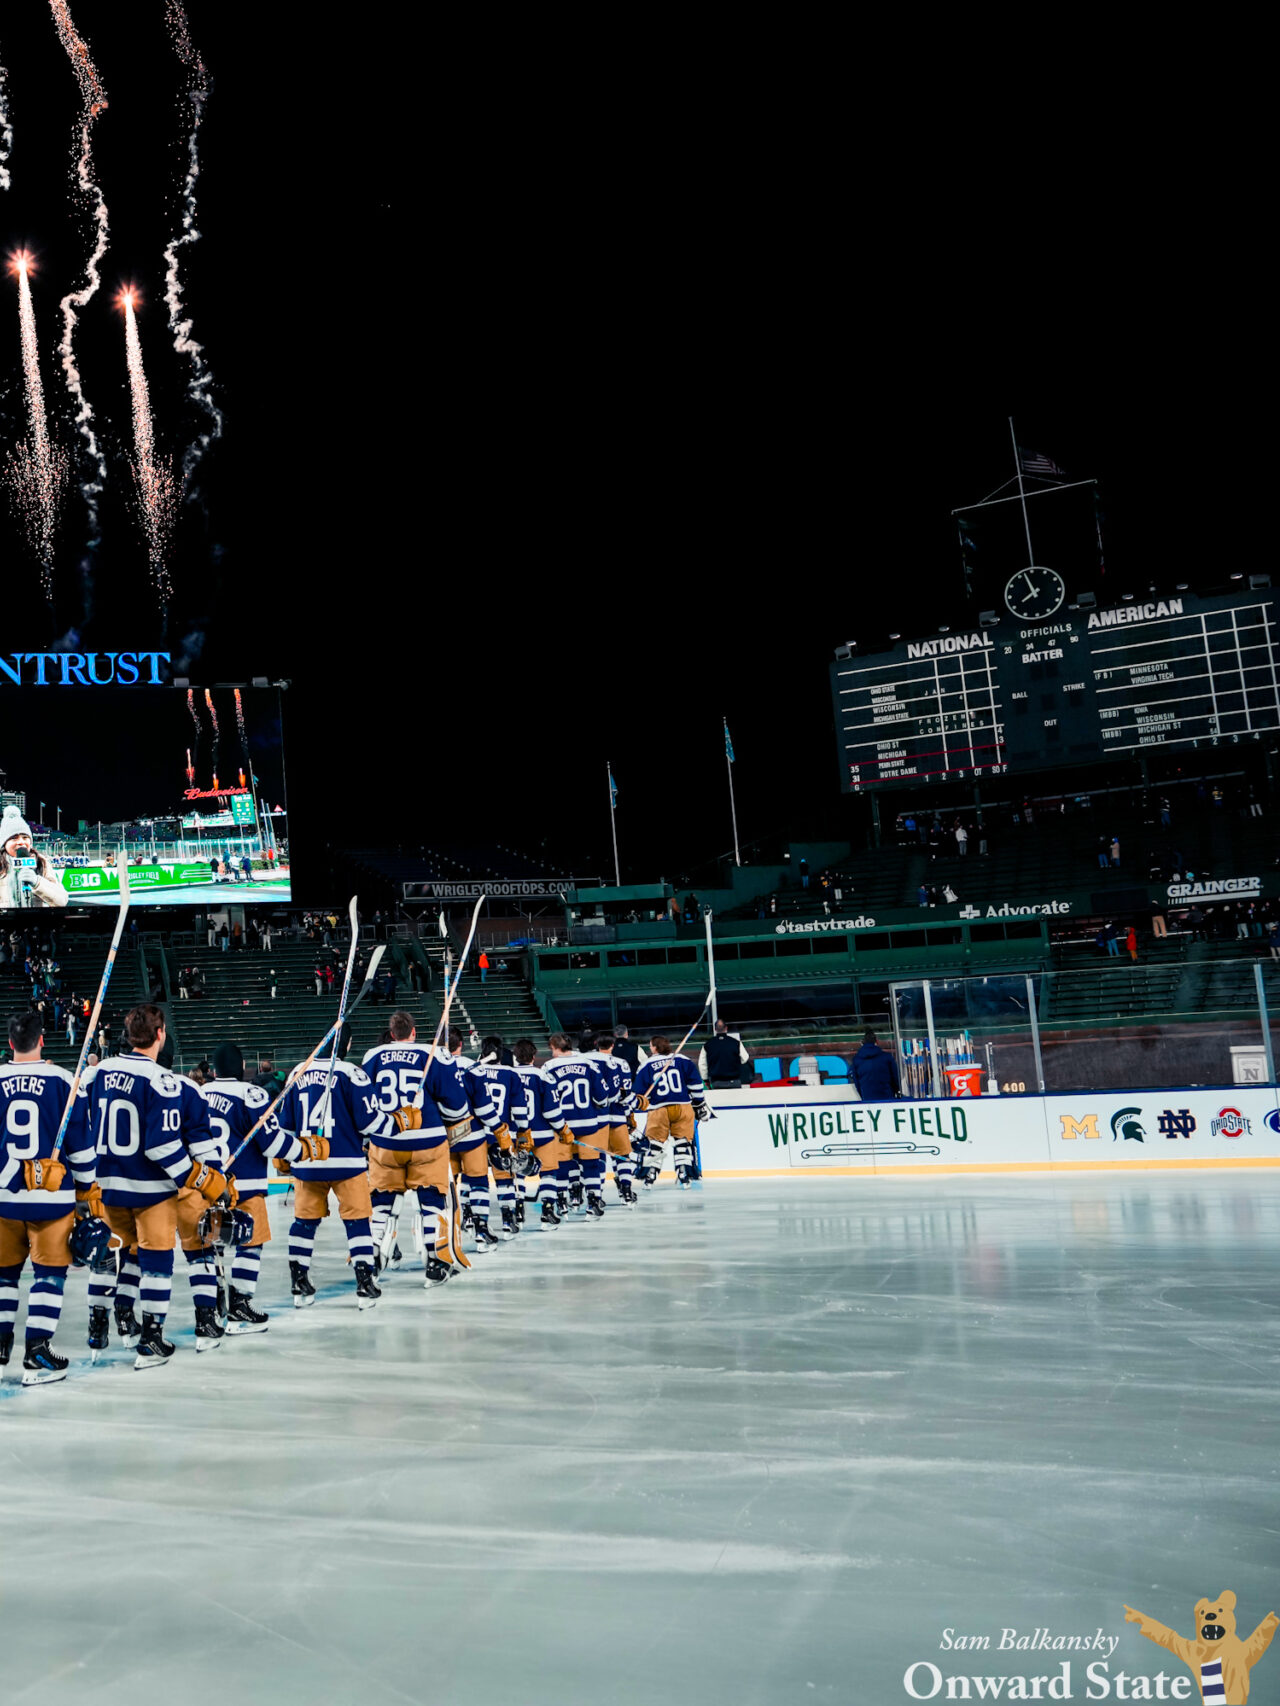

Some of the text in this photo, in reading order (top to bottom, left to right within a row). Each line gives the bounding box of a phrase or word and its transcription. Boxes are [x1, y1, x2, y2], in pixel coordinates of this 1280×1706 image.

[1087, 598, 1184, 629] AMERICAN
[1020, 623, 1073, 639] OFFICIALS
[907, 632, 993, 658] NATIONAL
[1021, 648, 1064, 664] BATTER
[1130, 663, 1169, 675] MINNESOTA
[1158, 671, 1174, 680] TECH
[1062, 682, 1086, 692] STRIKE
[1011, 691, 1028, 700] BALL
[872, 703, 906, 714] WISCONSIN
[1044, 718, 1057, 727] OUT
[1136, 712, 1175, 724] WISCONSIN
[1137, 721, 1181, 734] MICHIGAN ST
[1139, 735, 1156, 743] OHIO
[1193, 732, 1260, 748] 1 2 3 4
[850, 766, 860, 774] 35
[900, 766, 918, 776] DAME
[924, 774, 929, 783] 1
[942, 772, 947, 781] 2
[184, 786, 248, 800] Budweiser
[432, 881, 576, 898] WRIGLEYROOFTOPS.COM
[1167, 877, 1261, 899] GRAINGER
[986, 901, 1070, 918] Advocate
[380, 1050, 420, 1065] SERGEEV
[653, 1068, 682, 1096] 30
[953, 1075, 968, 1090] G
[1243, 1068, 1260, 1081] N
[1, 1076, 46, 1098] PETERS
[376, 1068, 424, 1111] 35
[557, 1078, 590, 1109] 20
[1003, 1082, 1026, 1093] 400
[362, 1093, 379, 1114] 14
[162, 1109, 181, 1132] 10
[298, 1092, 336, 1138] 14
[6, 1099, 39, 1160] 9
[96, 1098, 140, 1156] 10
[259, 1112, 280, 1135] 13
[768, 1107, 969, 1148] WRIGLEY FIELD
[1059, 1114, 1100, 1140] M
